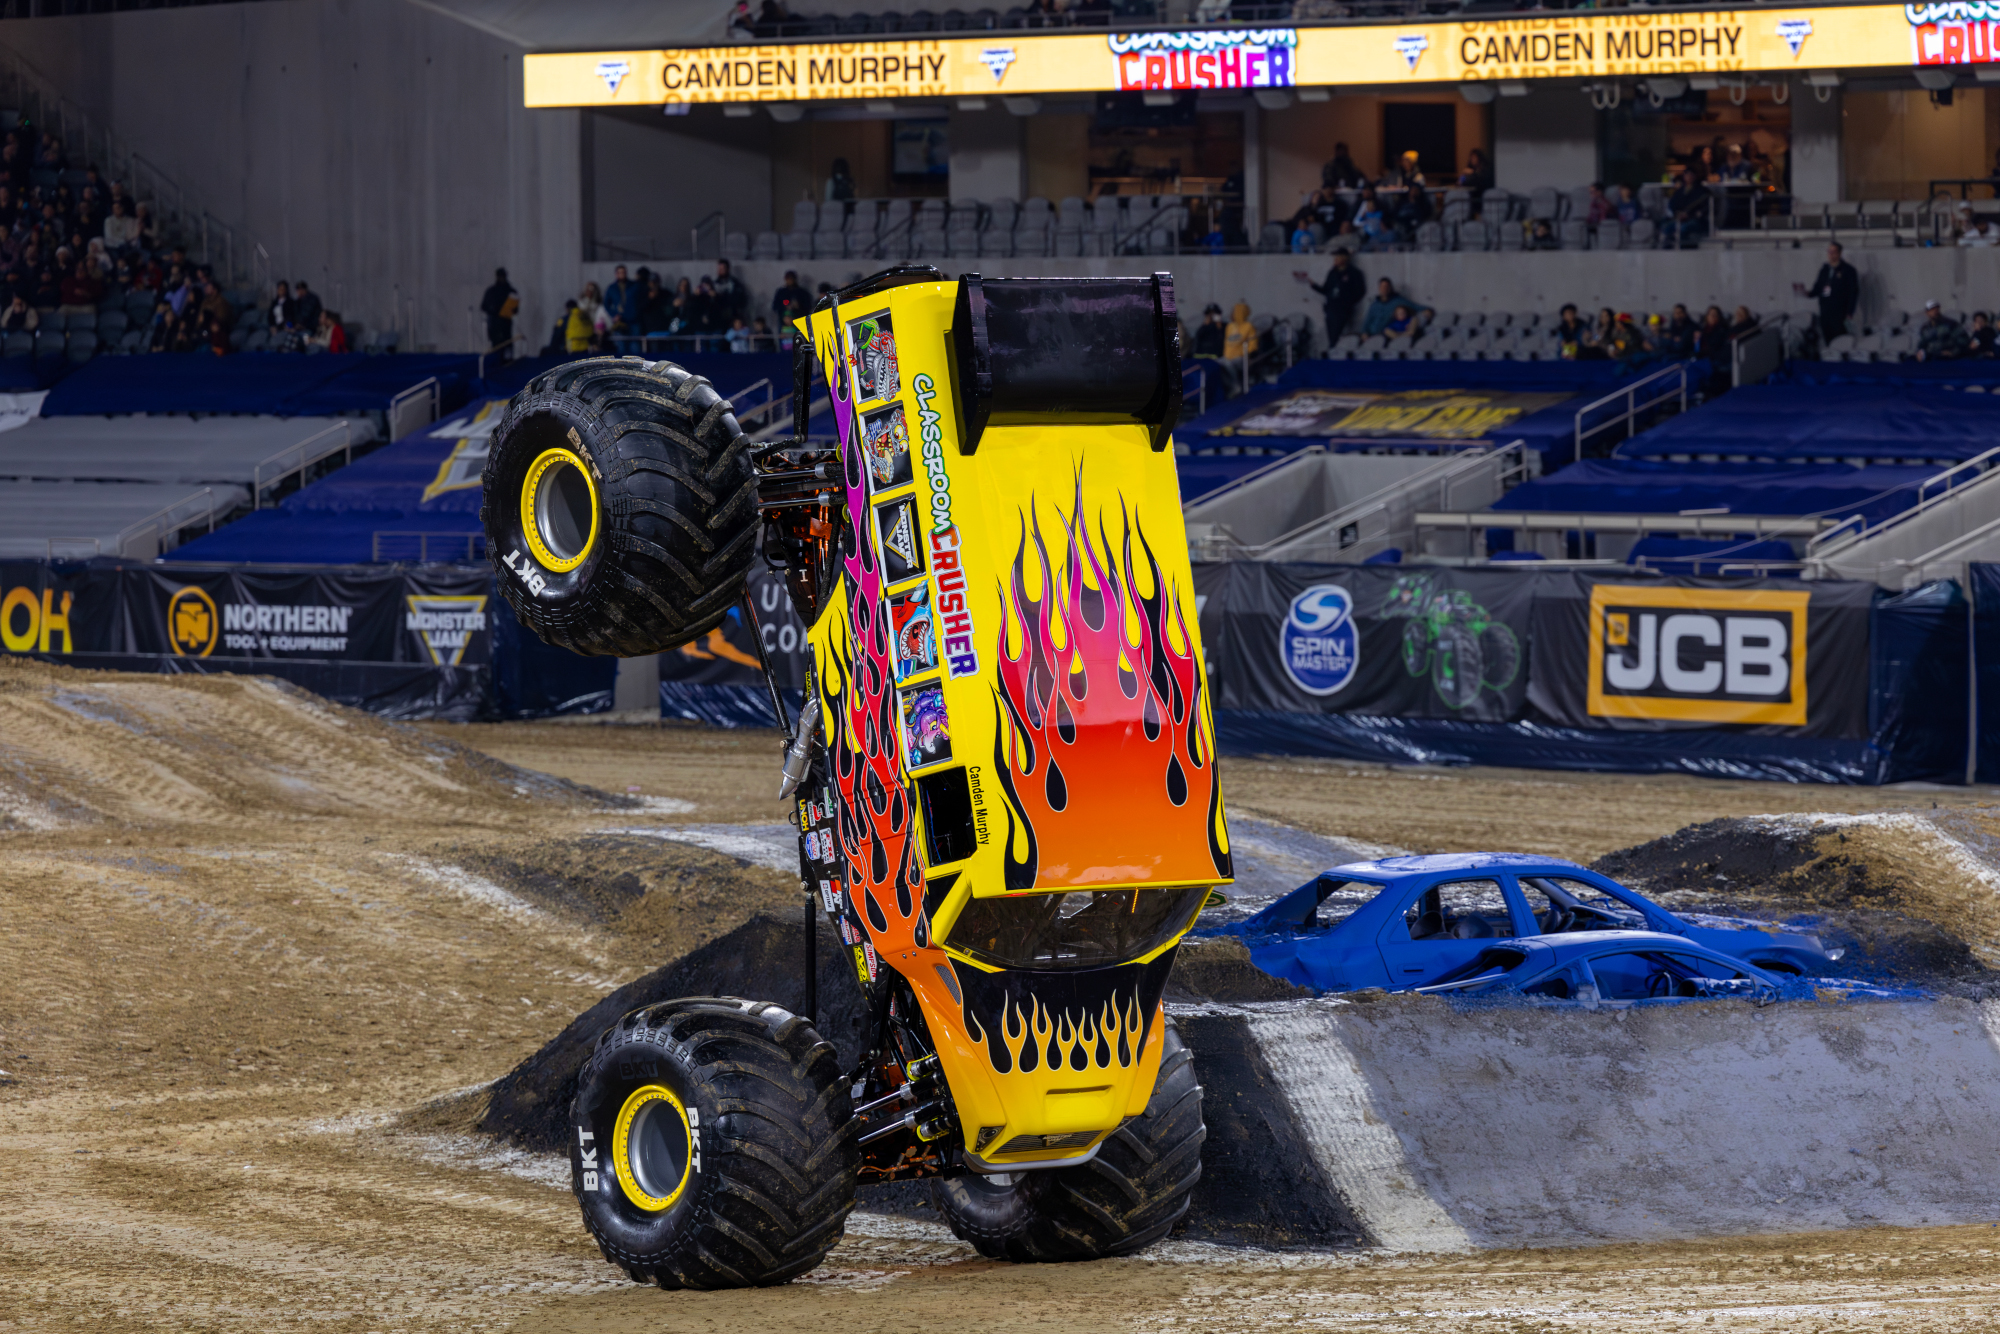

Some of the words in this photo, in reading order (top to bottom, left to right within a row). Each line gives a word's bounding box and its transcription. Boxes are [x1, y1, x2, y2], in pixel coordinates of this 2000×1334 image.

[1460, 31, 1594, 65] CAMDEN
[1606, 26, 1742, 60] MURPHY
[662, 58, 796, 90] CAMDEN
[809, 54, 945, 85] MURPHY
[1116, 46, 1295, 90] CRUSHER
[566, 426, 603, 480] BKT
[913, 373, 953, 535] CLASSROOM
[896, 525, 907, 557] JAM
[898, 504, 914, 570] MONSTER
[502, 549, 547, 597] BKT
[224, 603, 349, 633] NORTHERN
[406, 611, 486, 631] MONSTER
[928, 525, 980, 680] CRUSHER
[224, 634, 258, 650] TOOL
[270, 635, 349, 651] EQUIPMENT
[428, 630, 465, 649] JAM
[1291, 636, 1346, 656] SPIN
[1606, 613, 1789, 696] JCB
[1292, 655, 1347, 671] MASTER
[969, 765, 985, 806] Camden
[800, 798, 809, 831] UNOH
[975, 808, 991, 845] Murphy
[865, 944, 877, 978] SIMPSON
[619, 1060, 659, 1080] BKT
[578, 1125, 599, 1191] BKT
[686, 1107, 702, 1174] BKT
